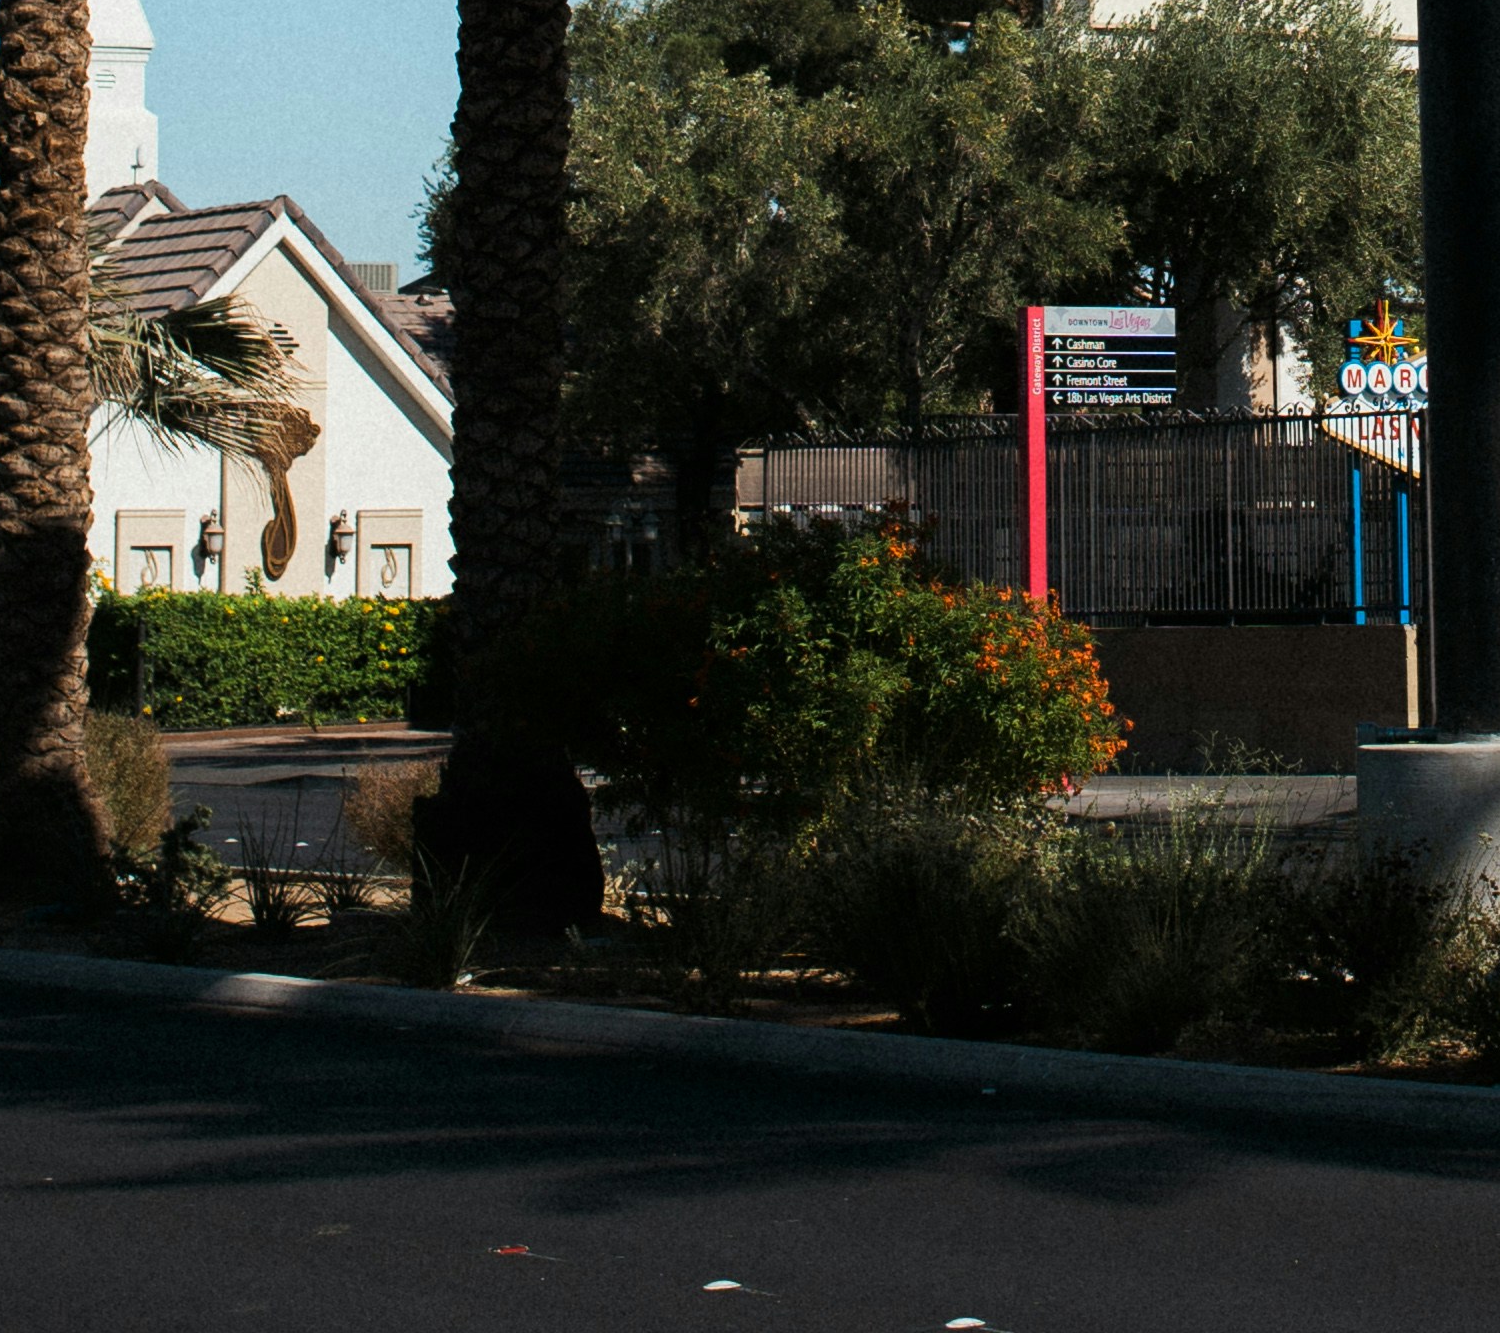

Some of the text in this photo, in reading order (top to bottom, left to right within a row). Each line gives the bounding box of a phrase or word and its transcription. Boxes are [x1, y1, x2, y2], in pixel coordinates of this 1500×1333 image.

[1068, 310, 1151, 332] DOWNTOWN Las Vegas
[1066, 338, 1105, 350] Cashman
[1032, 318, 1043, 395] Gateway District
[1066, 356, 1117, 368] Casino Core
[1066, 374, 1127, 387] Fremont Street
[1067, 392, 1171, 406] 18b Las Vegas Arts District
[1359, 416, 1399, 441] LAS
